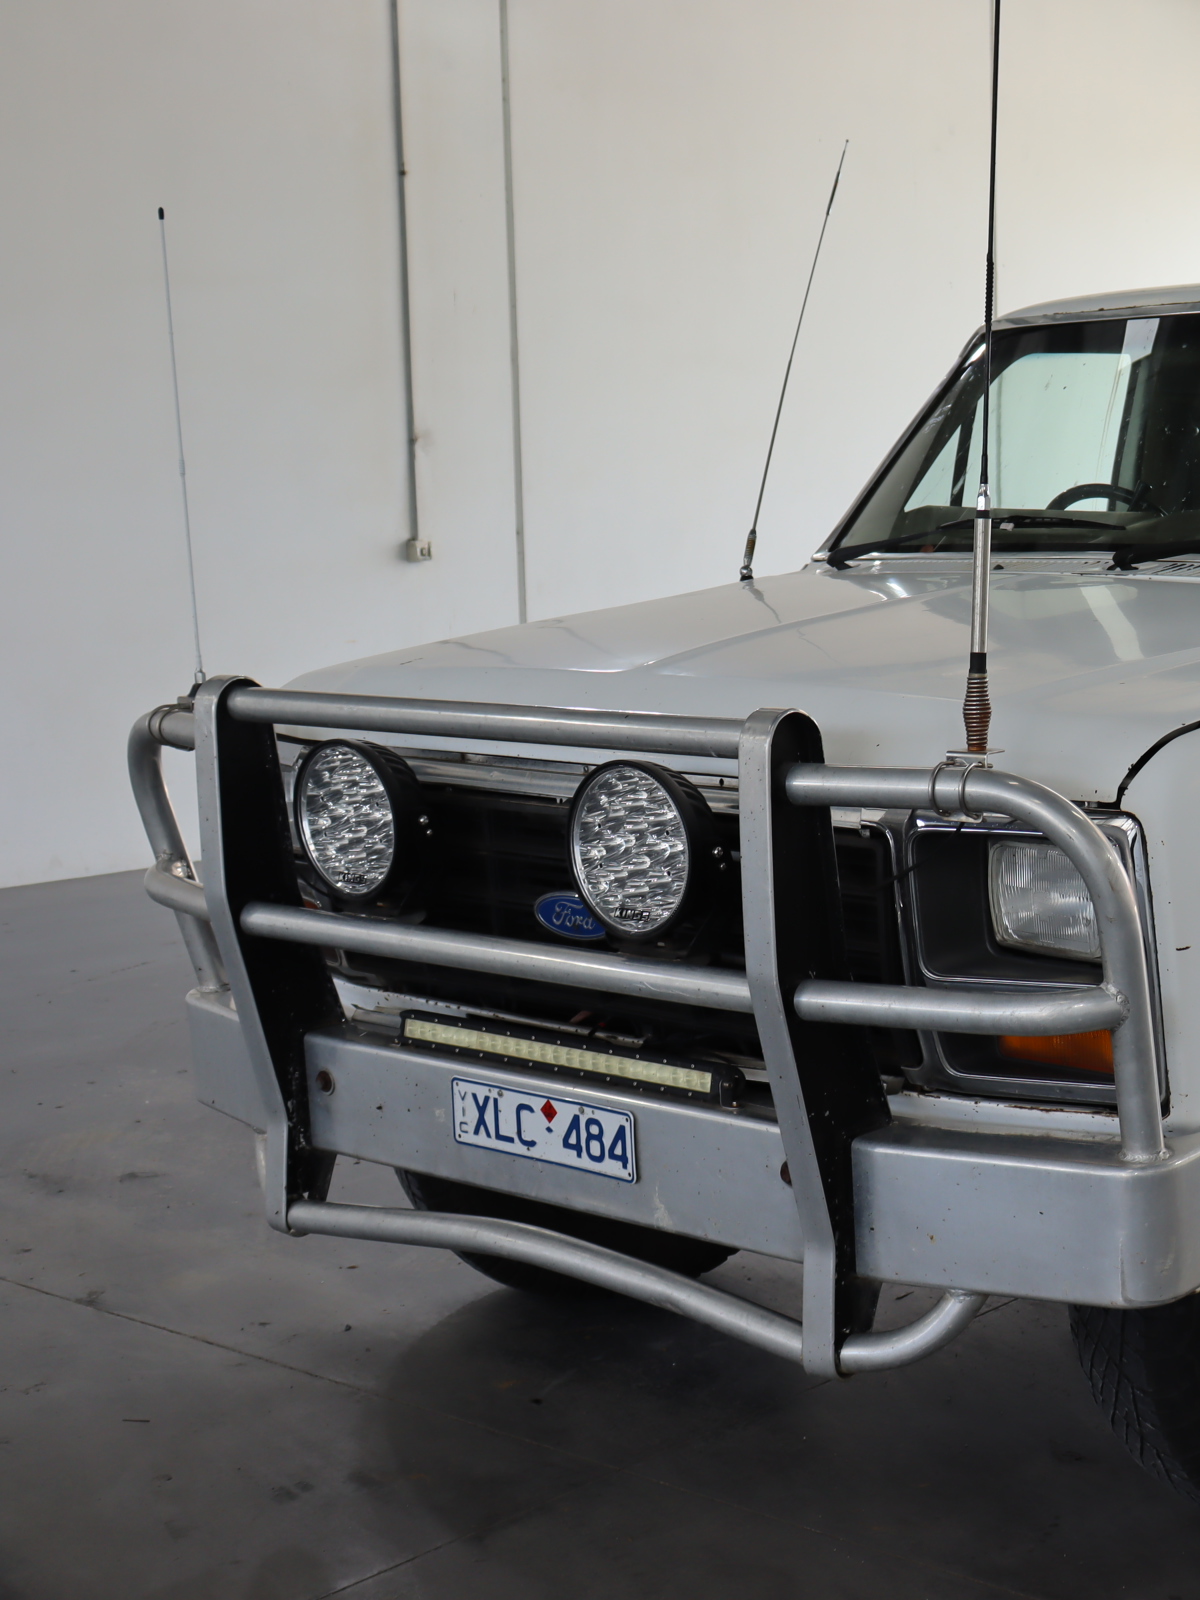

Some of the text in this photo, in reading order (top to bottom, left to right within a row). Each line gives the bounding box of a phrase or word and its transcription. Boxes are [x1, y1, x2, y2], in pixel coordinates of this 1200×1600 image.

[552, 901, 595, 930] Ford
[614, 907, 650, 921] KINGS
[458, 1090, 469, 1134] VIC
[471, 1092, 628, 1170] XLC 484
